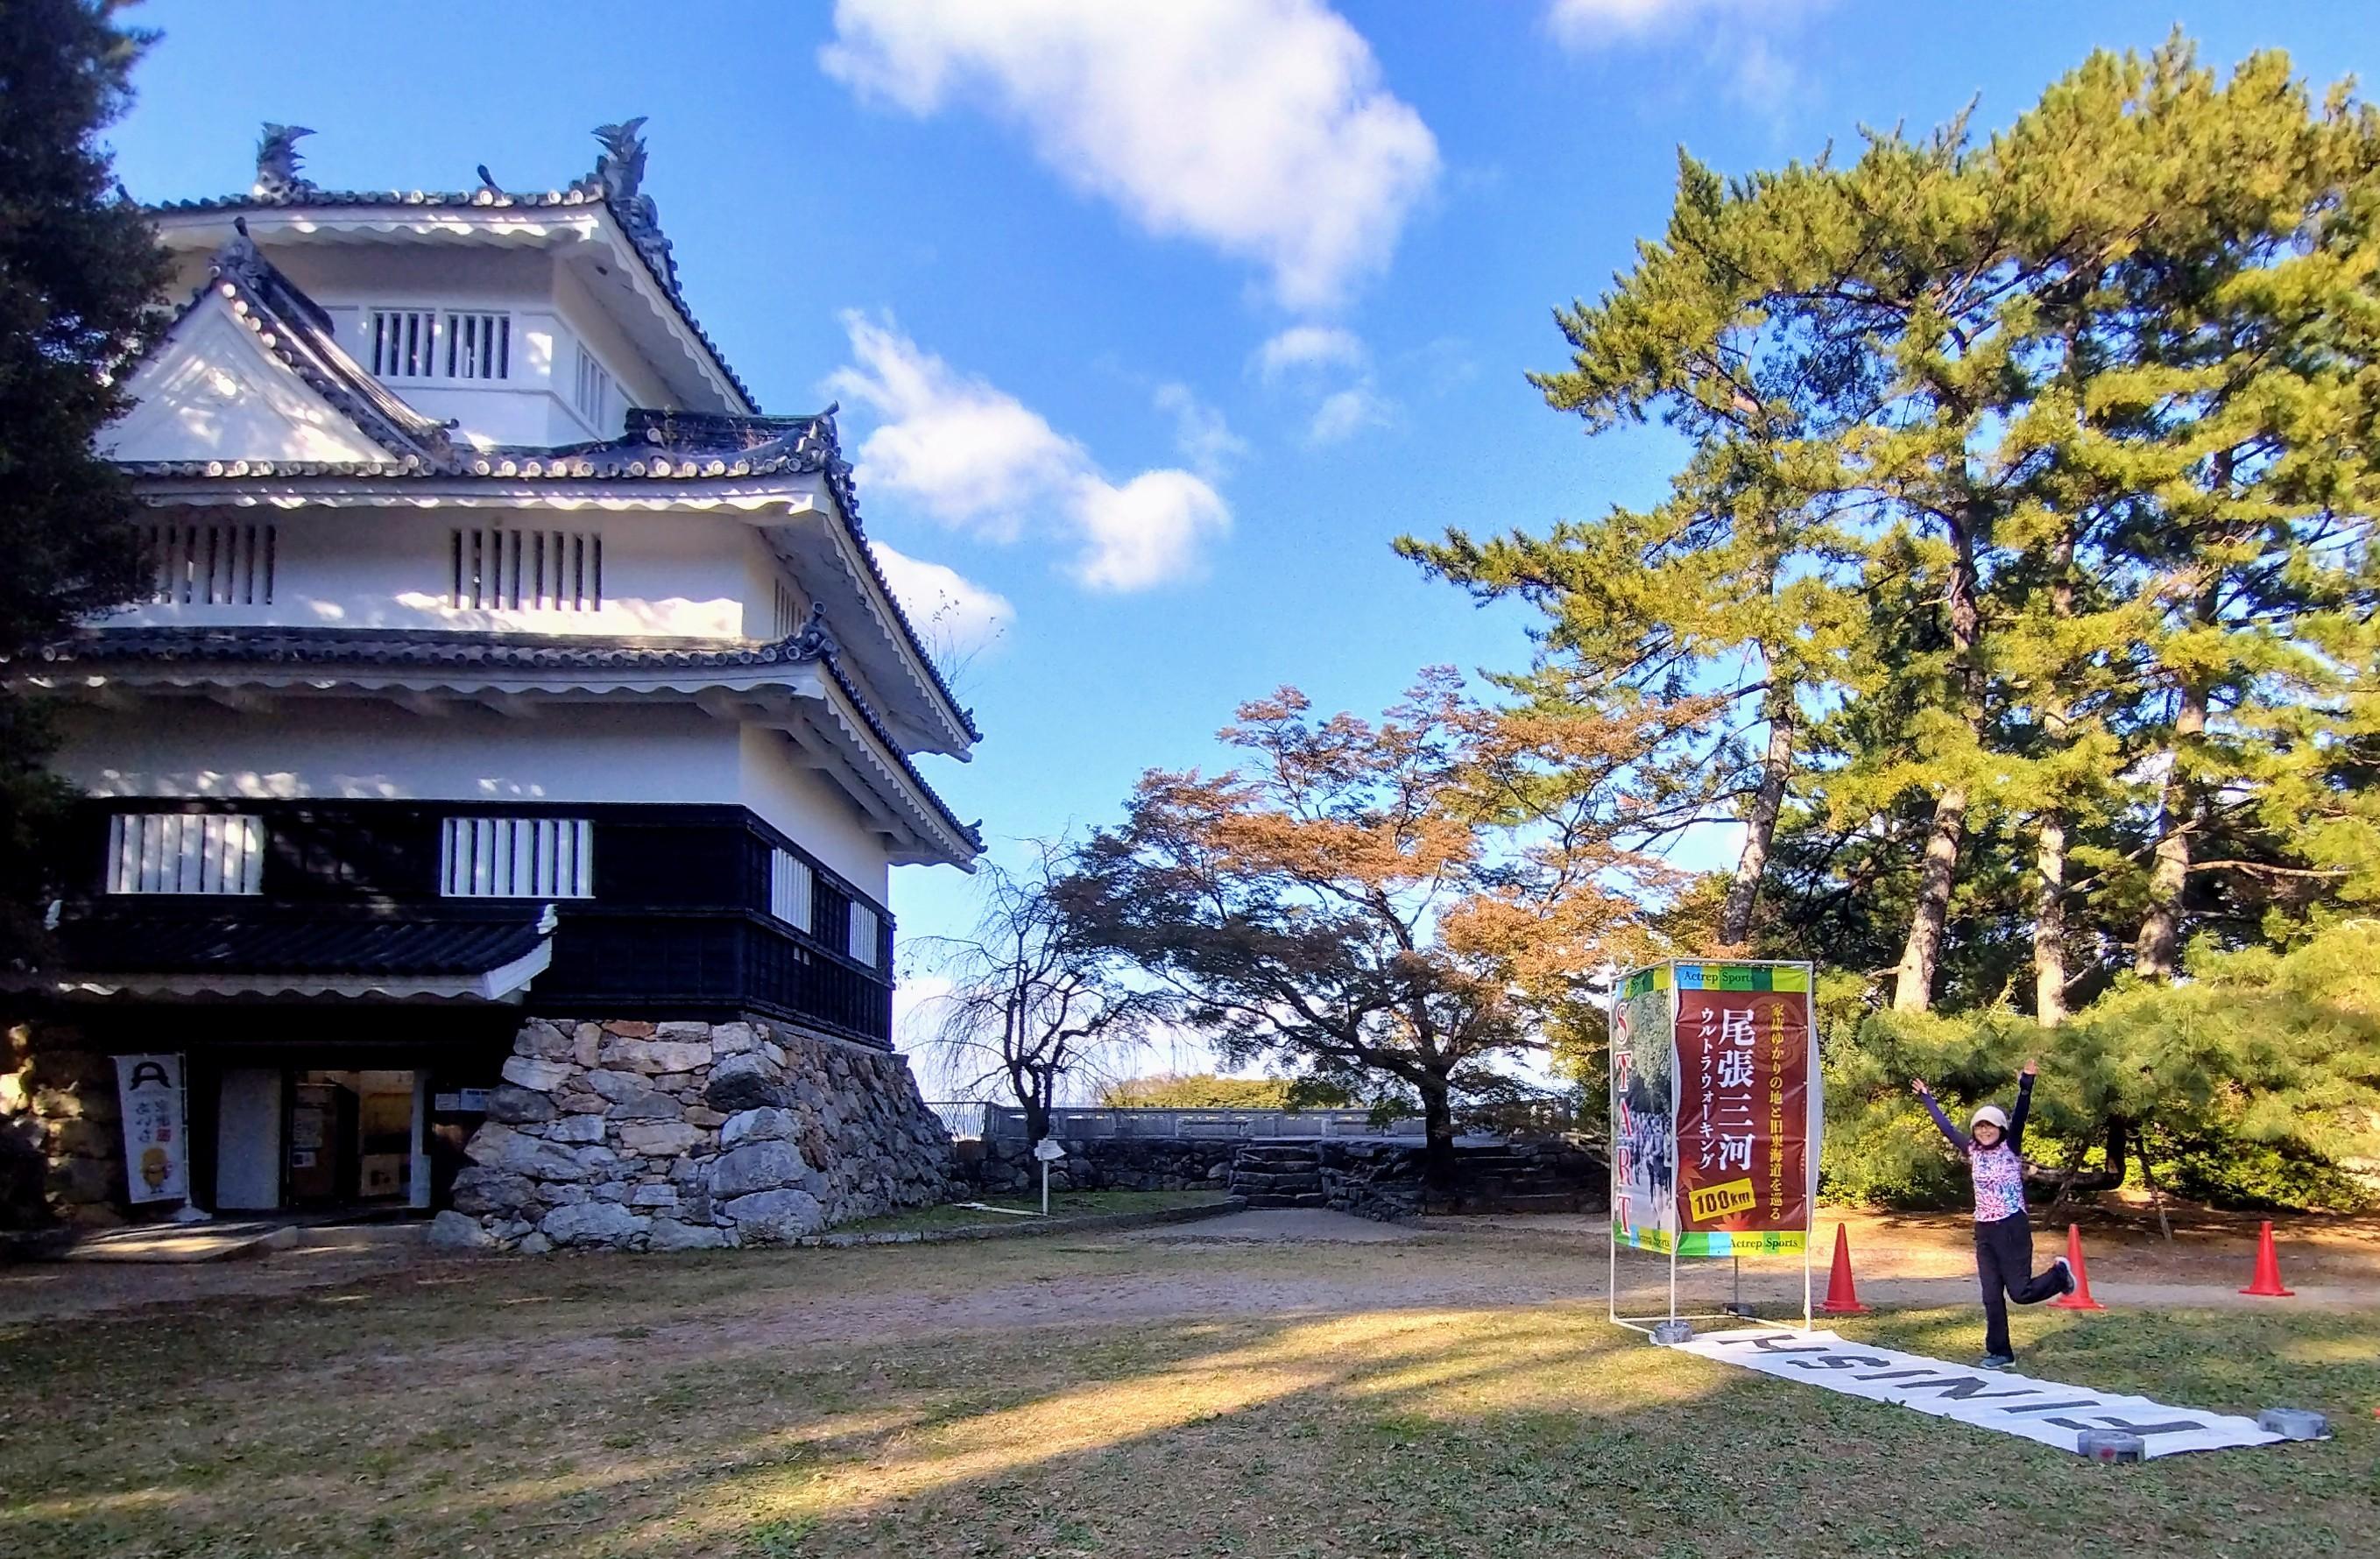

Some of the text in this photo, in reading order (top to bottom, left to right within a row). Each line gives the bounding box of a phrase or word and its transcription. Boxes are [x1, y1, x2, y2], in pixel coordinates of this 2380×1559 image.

[1684, 971, 1719, 984] Actrep
[1614, 1002, 1634, 1237] START
[1698, 1007, 1717, 1170] ウルトラウォーキング
[1717, 1008, 1756, 1171] 尾張三河
[1769, 1003, 1784, 1220] 家康ゆかりの地と旧東海道を巡る
[1695, 1189, 1750, 1215] 100km
[1730, 1237, 1798, 1250] Actrep Sports
[1717, 1334, 2208, 1436] FINISH
